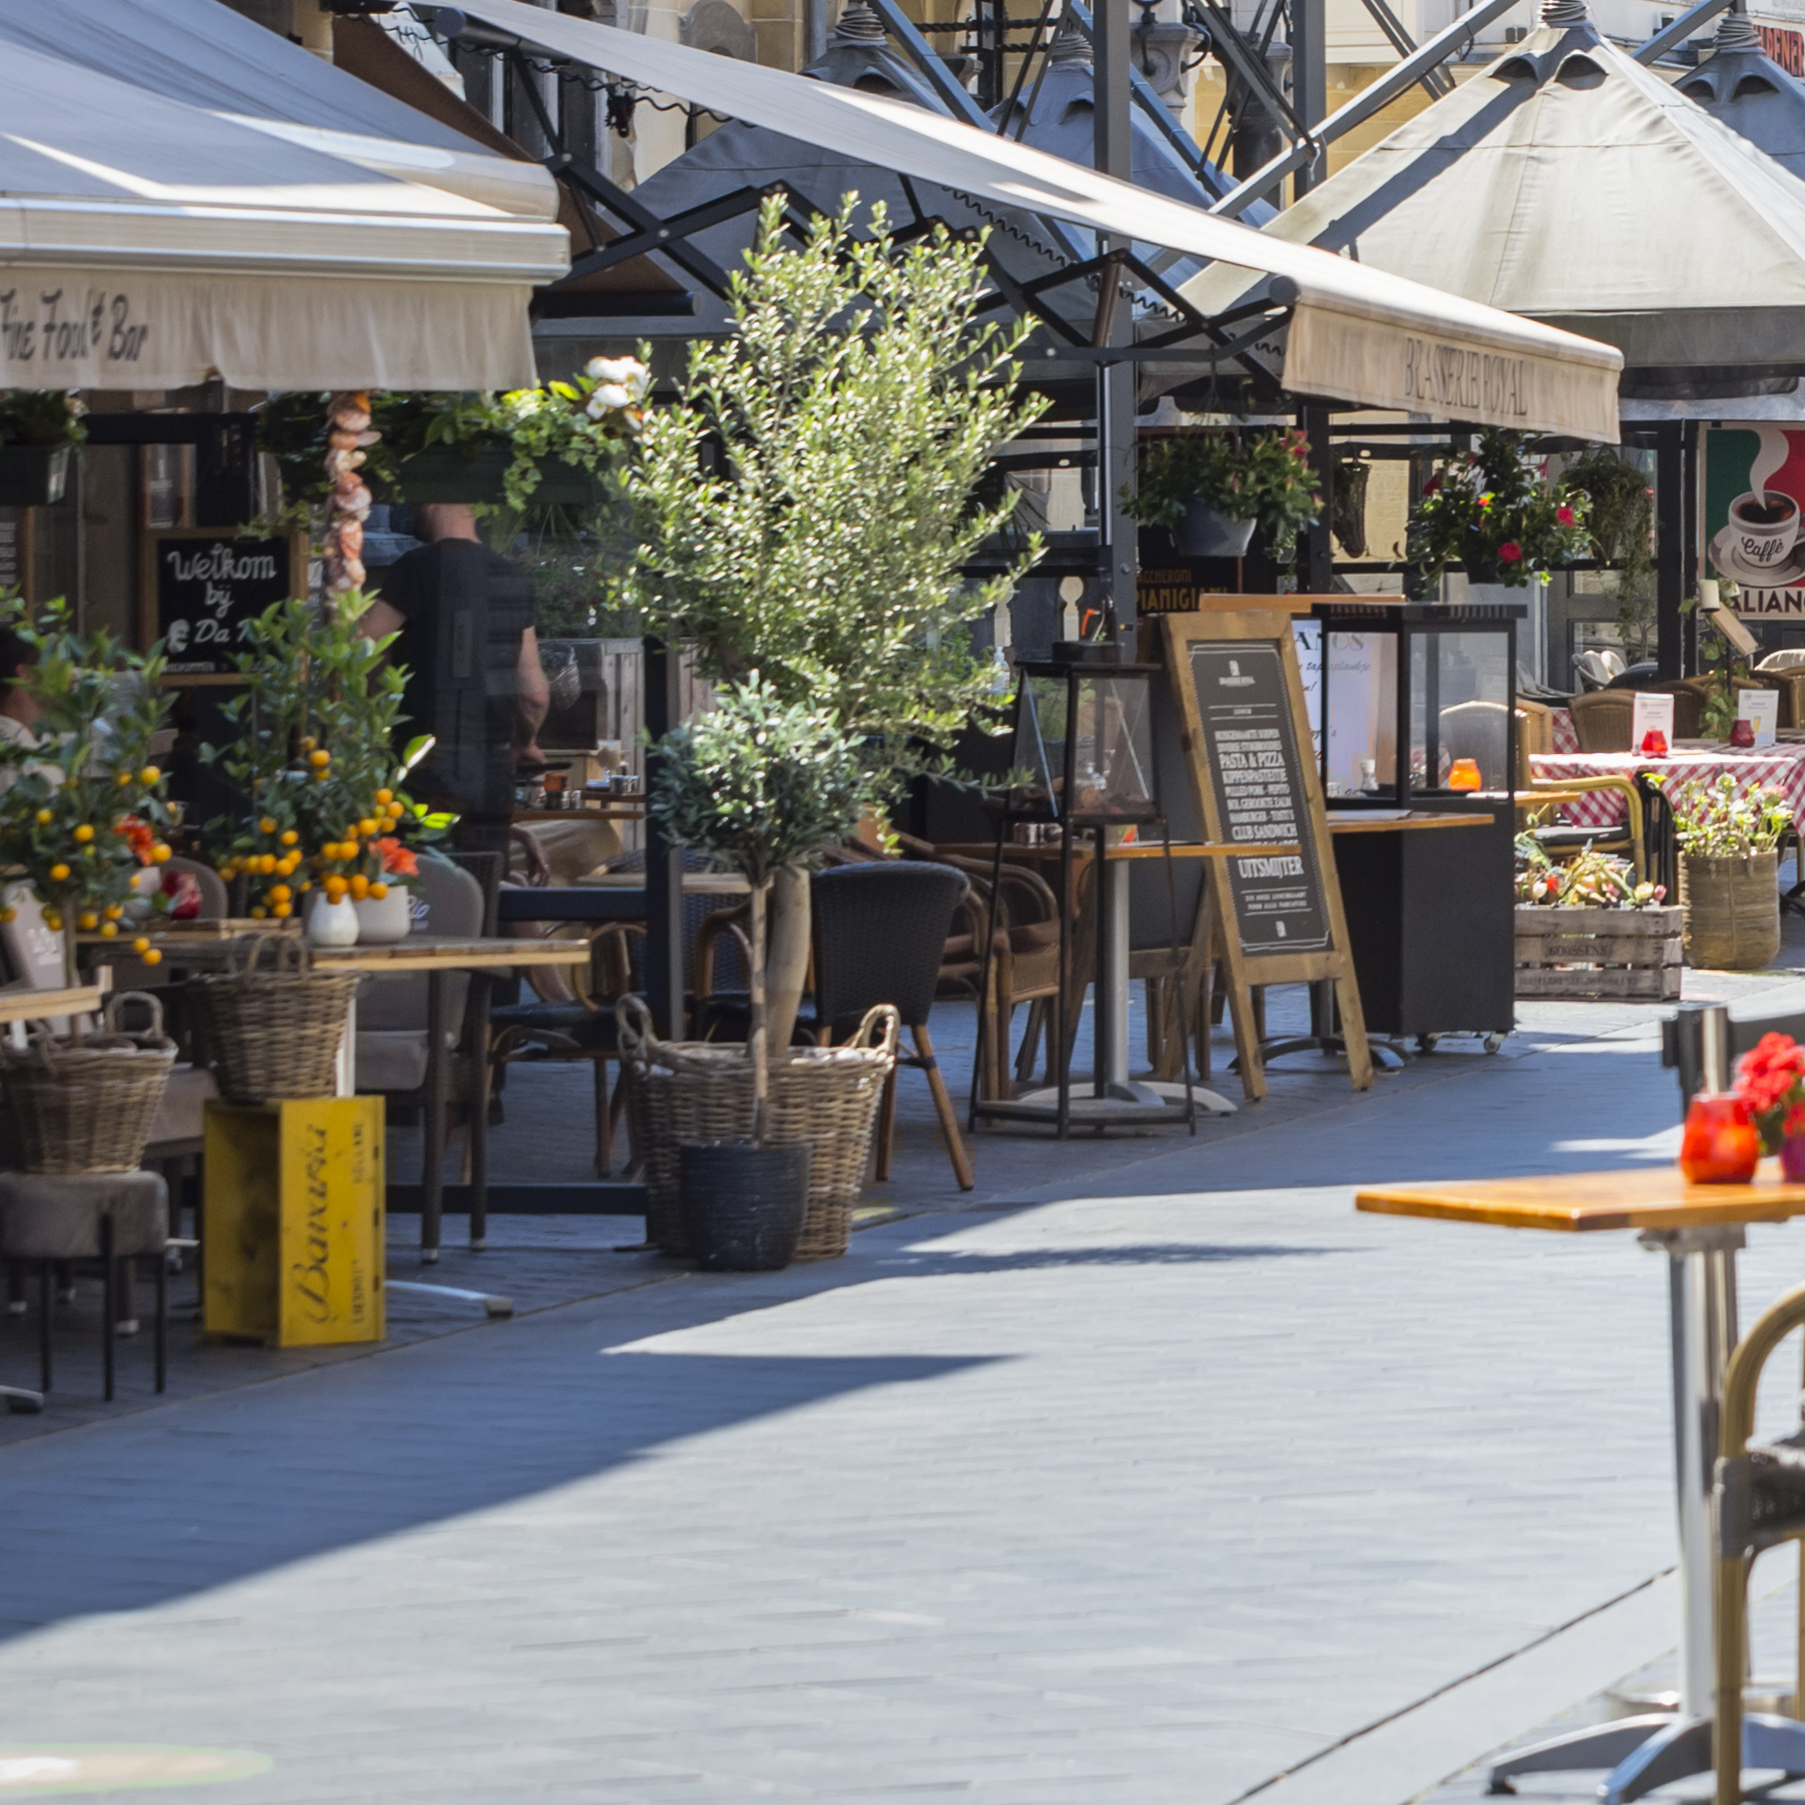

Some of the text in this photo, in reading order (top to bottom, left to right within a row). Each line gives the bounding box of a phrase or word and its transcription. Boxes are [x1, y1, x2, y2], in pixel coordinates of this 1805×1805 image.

[106, 293, 149, 361] Bar
[167, 543, 278, 580] Welkom
[1741, 537, 1785, 562] Caffè
[1219, 753, 1248, 770] PASTA
[1257, 751, 1286, 767] PIZZA
[1232, 823, 1298, 840] CLUB SANDWICH
[1237, 855, 1304, 879] UITSMIJTER
